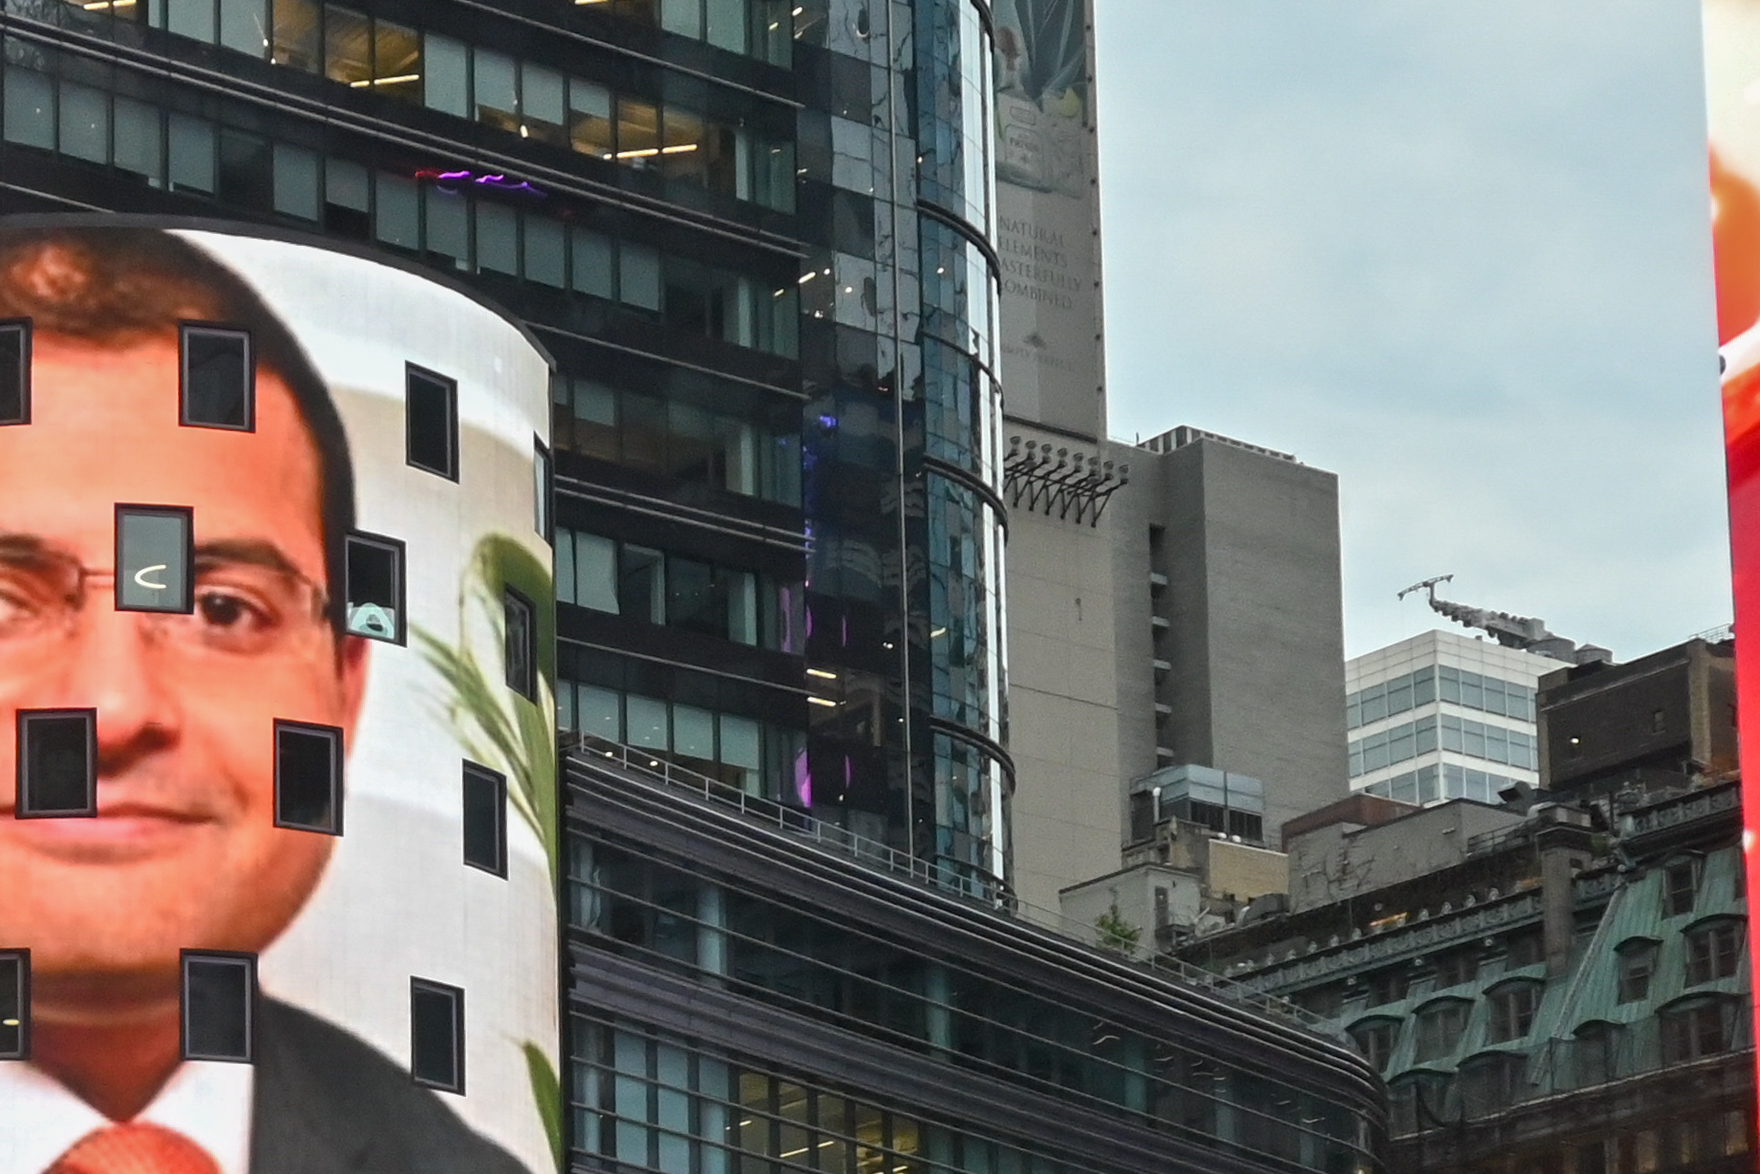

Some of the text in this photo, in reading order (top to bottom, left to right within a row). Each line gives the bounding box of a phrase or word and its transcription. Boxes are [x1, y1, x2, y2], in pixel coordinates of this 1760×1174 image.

[999, 215, 1065, 247] NATURAL
[998, 235, 1068, 268] ELEMENTS
[1001, 257, 1082, 291] ASTERFULLY
[1002, 278, 1072, 309] OMBINED
